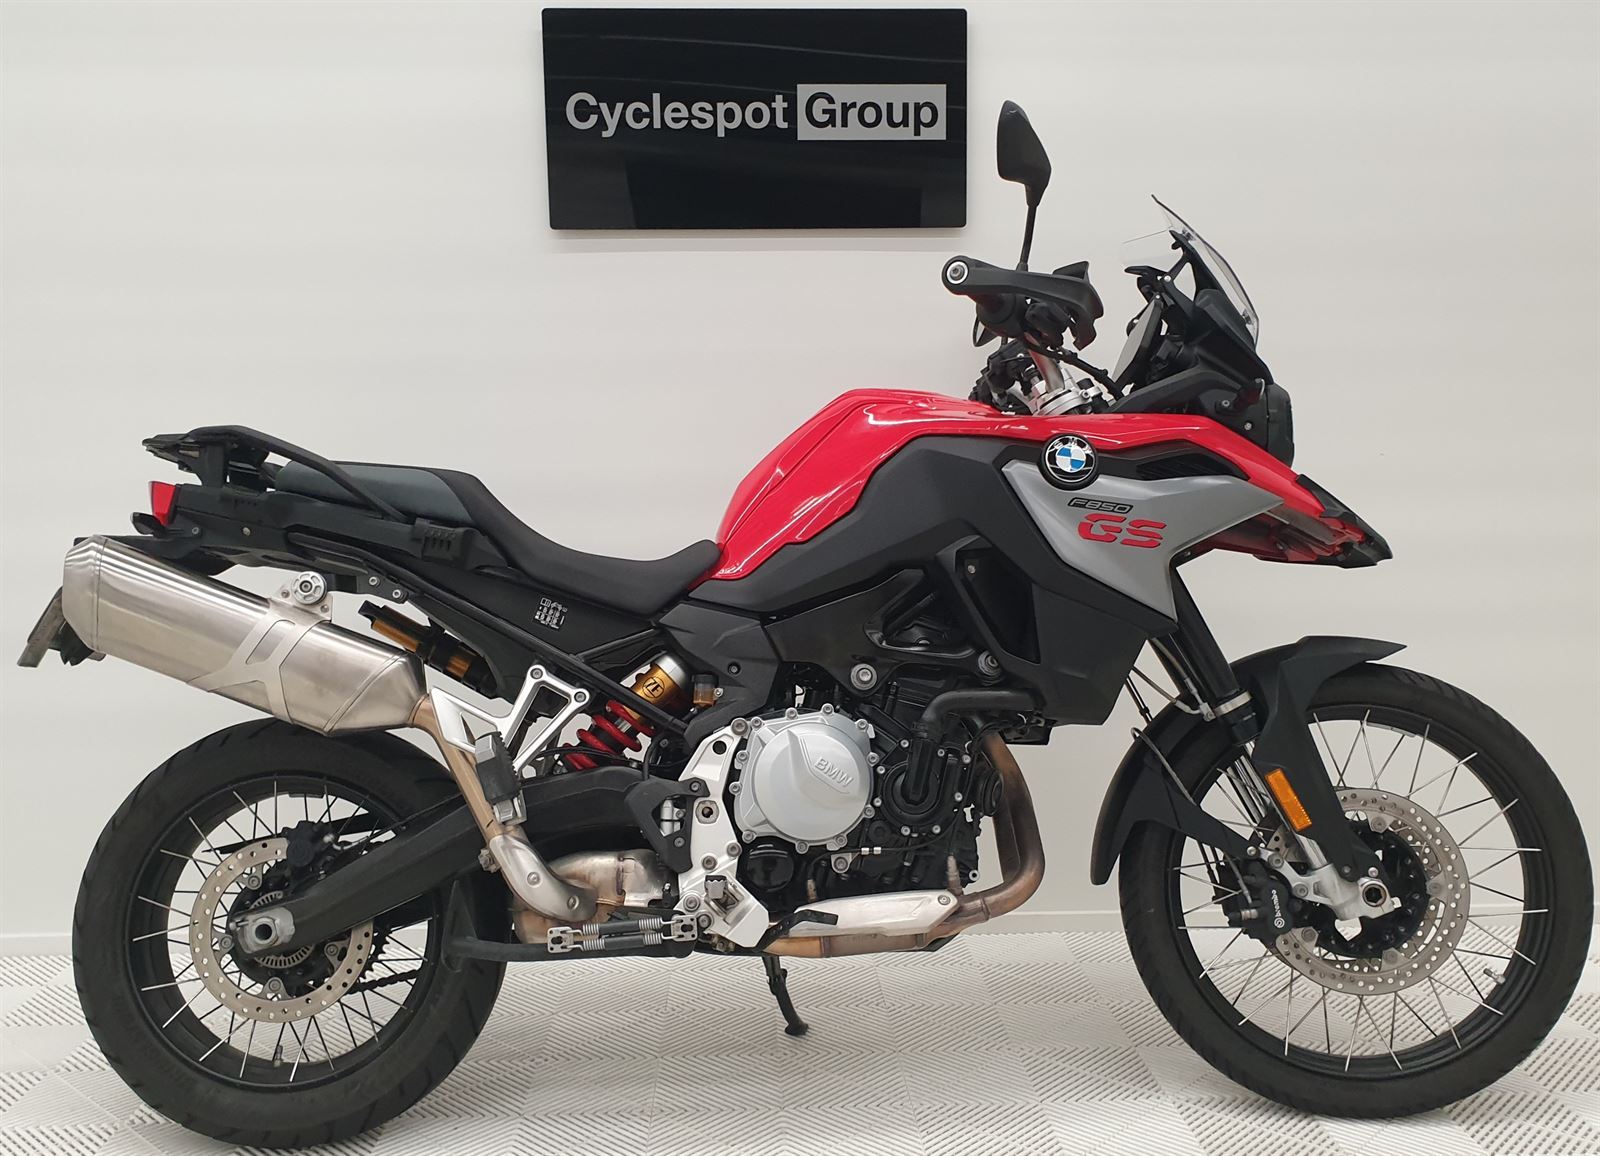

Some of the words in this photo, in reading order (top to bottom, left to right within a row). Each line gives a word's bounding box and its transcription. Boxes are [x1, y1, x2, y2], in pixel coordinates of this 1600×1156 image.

[565, 92, 789, 138] Cyclespot
[804, 91, 940, 137] Group
[1069, 498, 1131, 513] F850
[1077, 512, 1168, 549] GS
[813, 756, 855, 788] BMW
